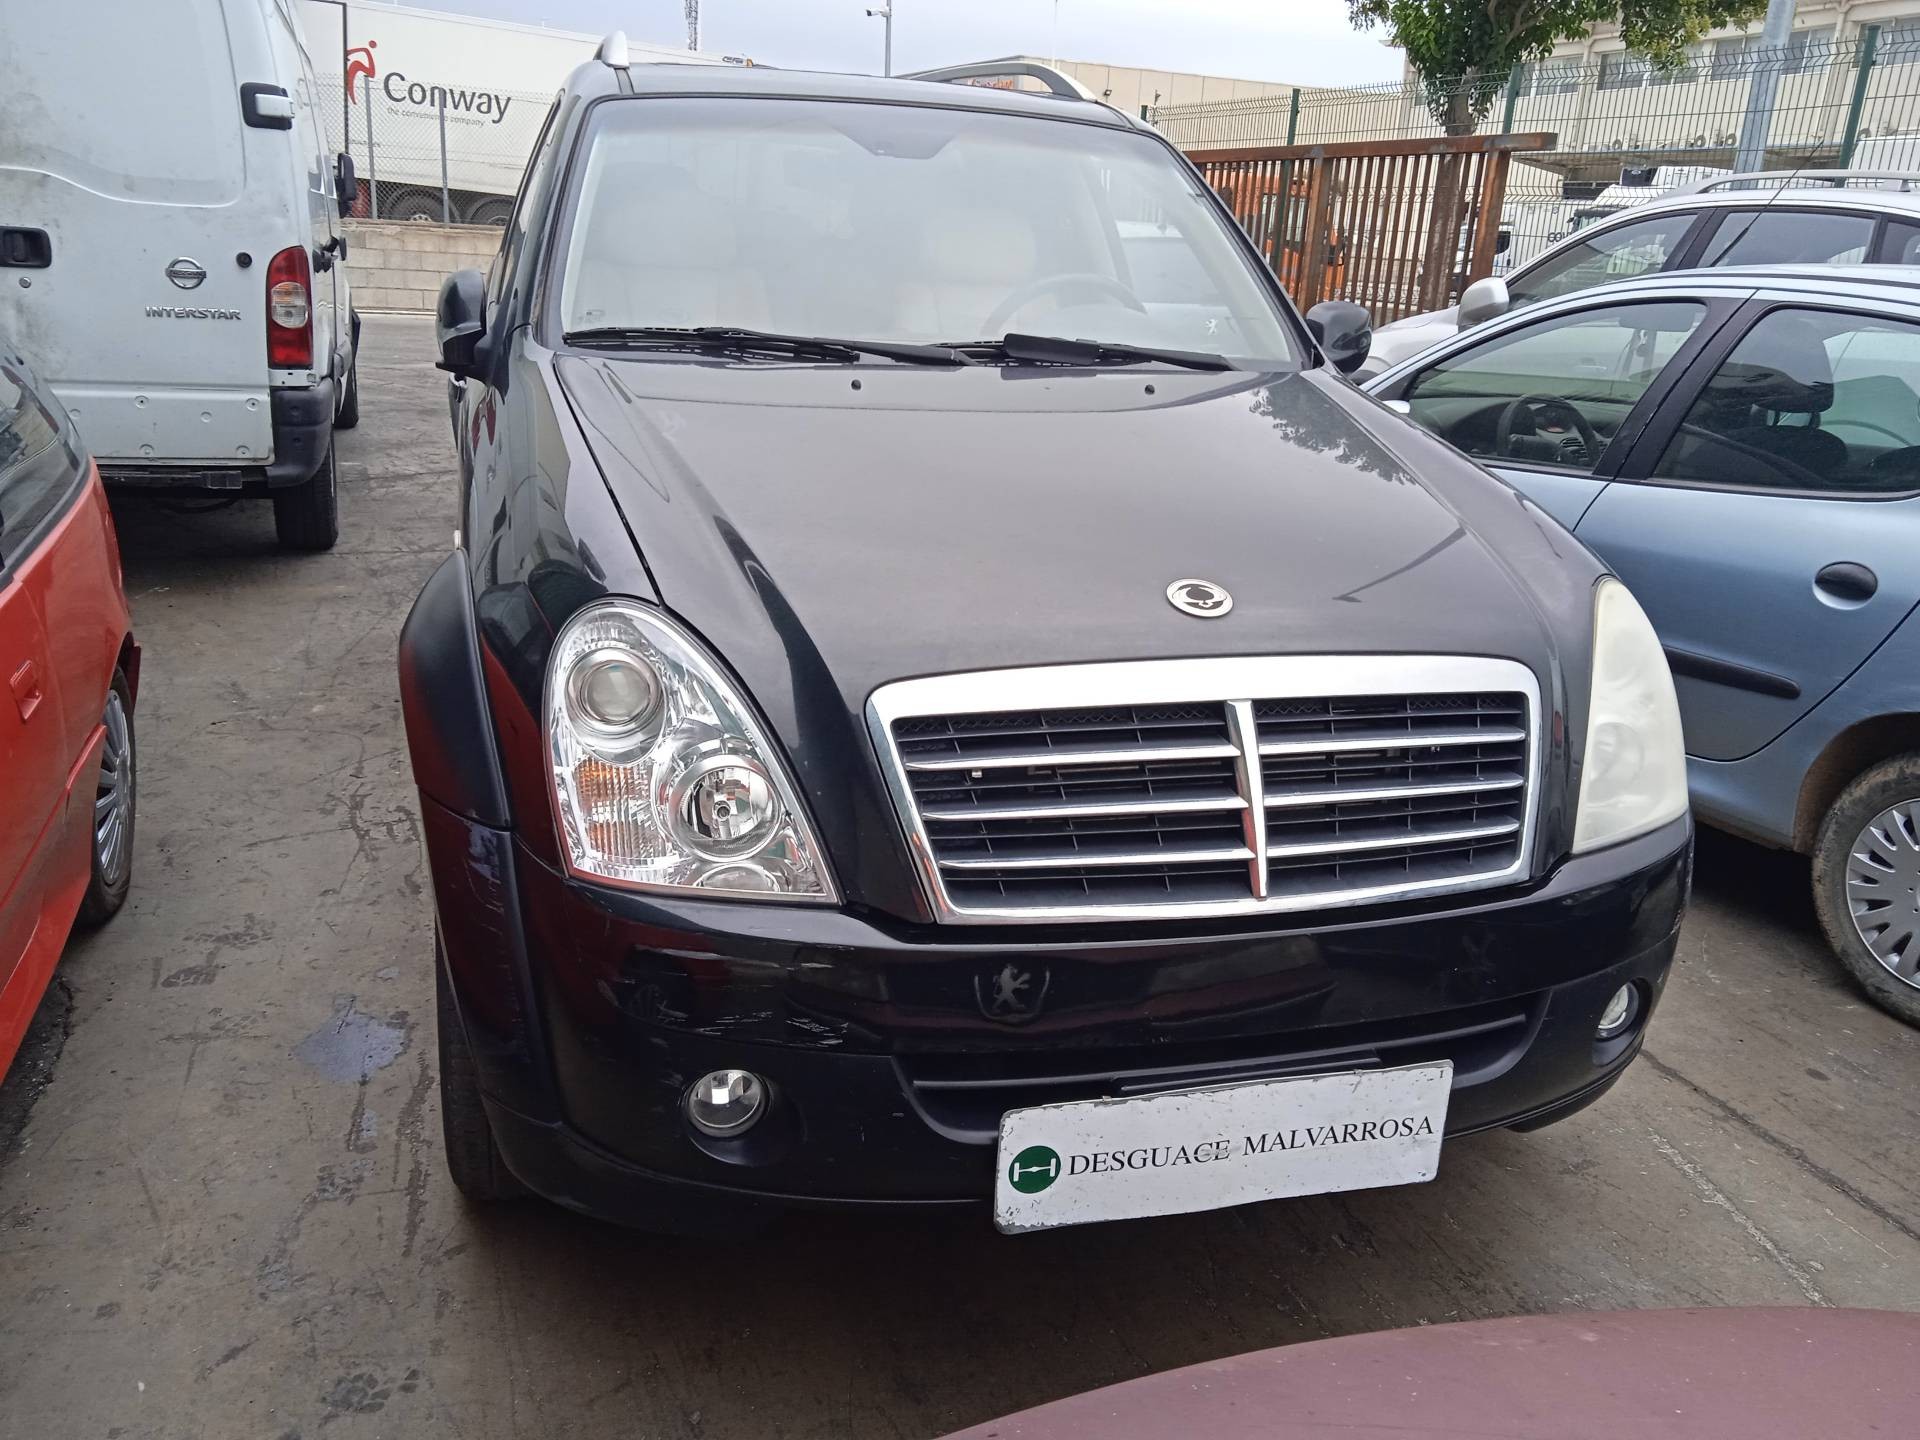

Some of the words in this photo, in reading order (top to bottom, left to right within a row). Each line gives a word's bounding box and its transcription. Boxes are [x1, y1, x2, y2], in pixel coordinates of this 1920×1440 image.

[383, 72, 511, 124] Conway
[402, 109, 448, 121] conveniene
[145, 306, 242, 320] INTERSTAR
[1067, 1139, 1231, 1176] DESGUACE
[1242, 1115, 1434, 1157] MALVARROSA
